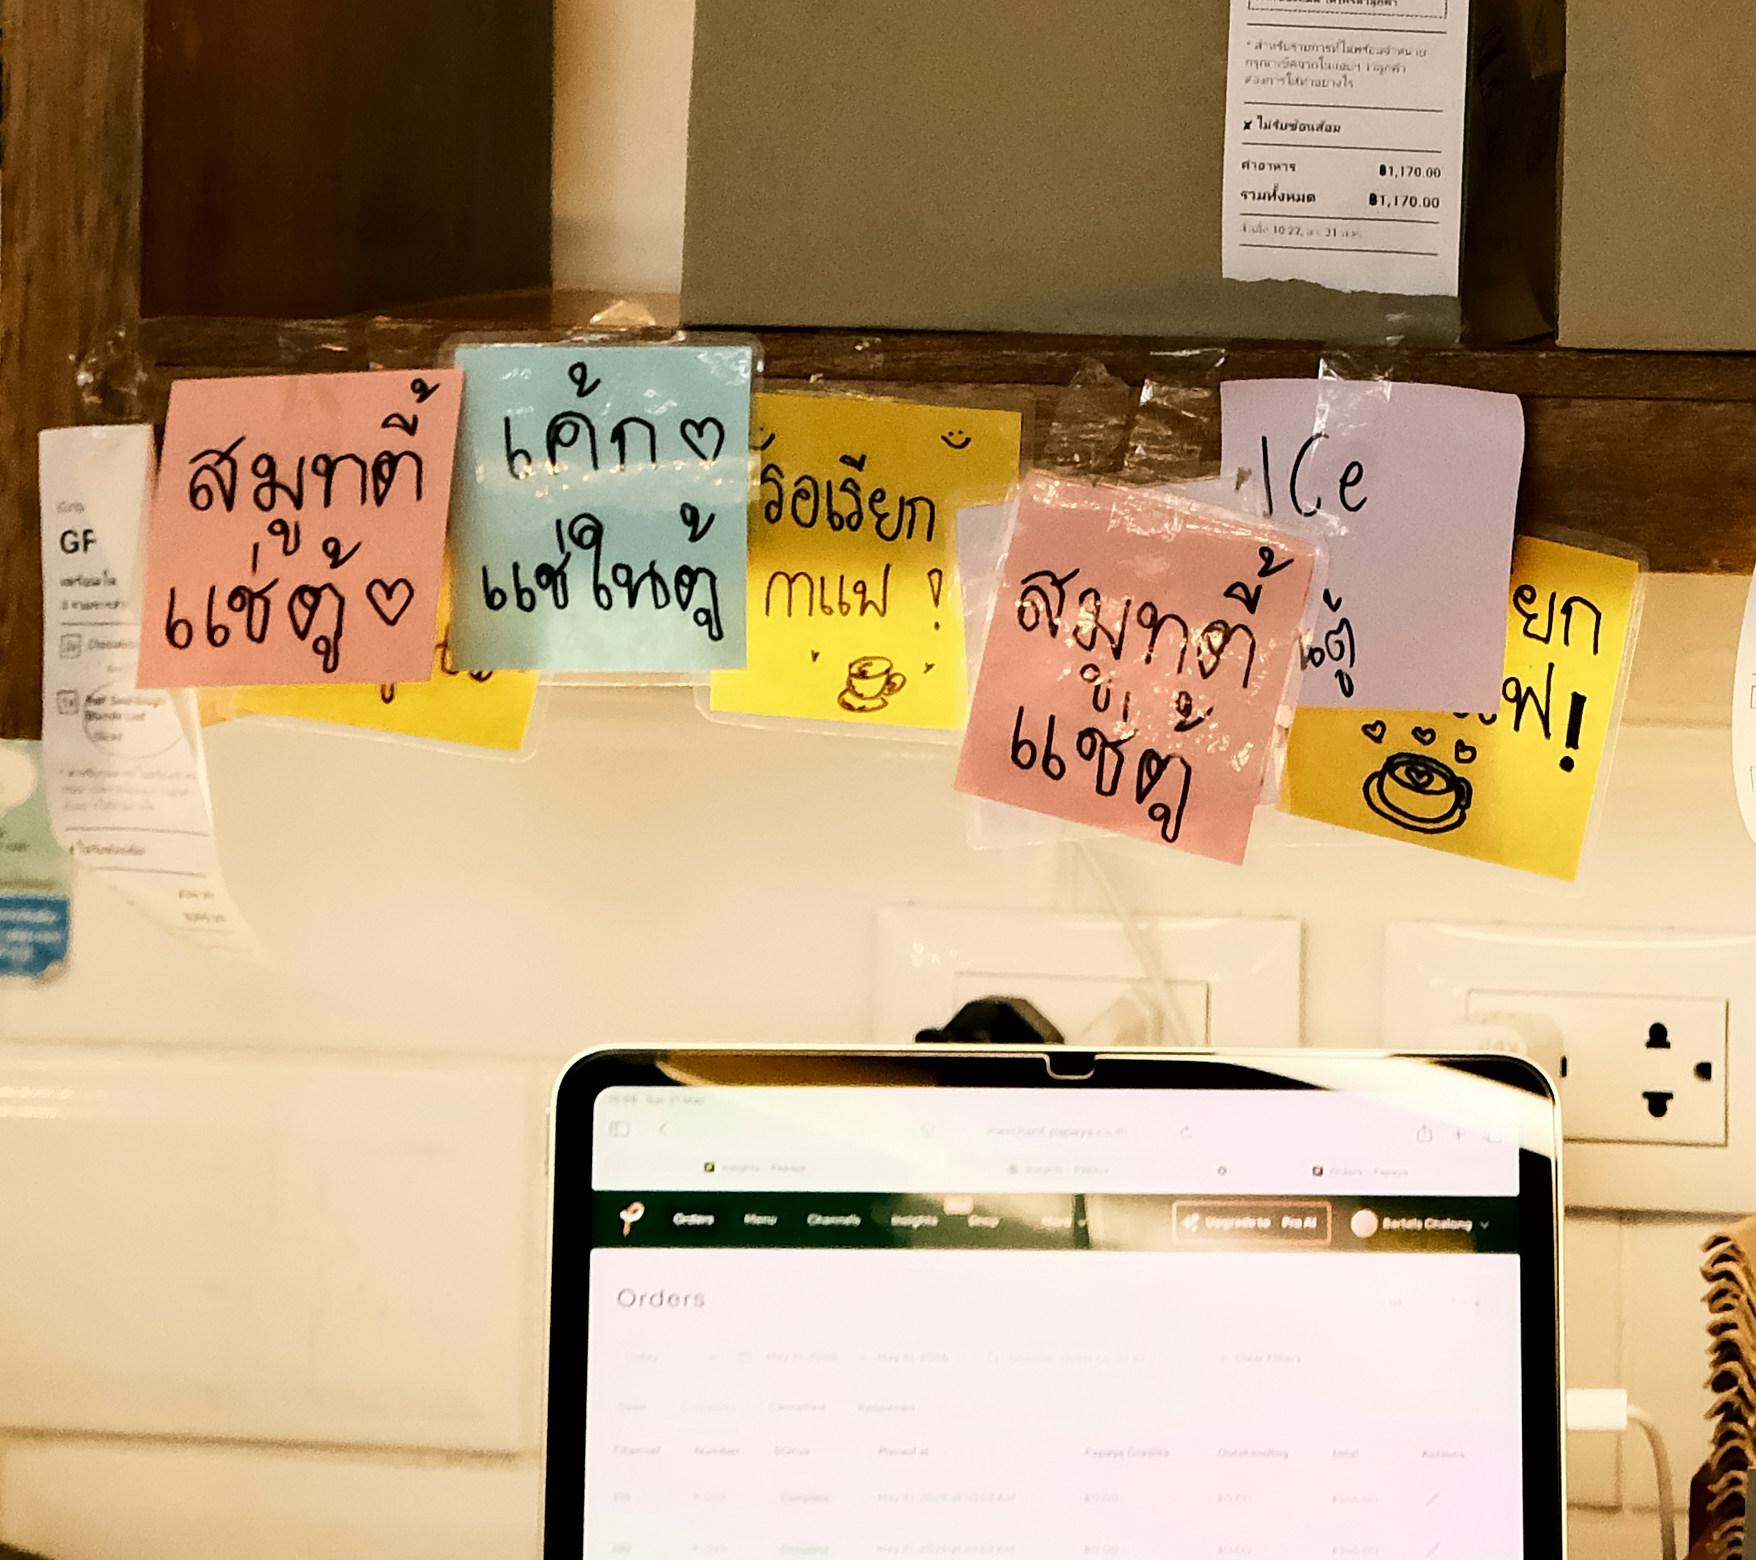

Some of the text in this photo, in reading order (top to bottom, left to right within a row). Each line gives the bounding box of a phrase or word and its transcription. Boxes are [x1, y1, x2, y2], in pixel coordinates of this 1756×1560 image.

[1240, 183, 1316, 203] รวมทั้งหมด
[1241, 160, 1297, 172] ค่าอาหาร
[187, 376, 442, 558] สมูทตี้
[502, 360, 659, 481] เค้ก
[58, 529, 99, 555] GF
[760, 452, 938, 544] รอเรียก
[164, 534, 365, 676] แช่ตู้
[480, 501, 726, 643] แช่ในตู้
[1014, 544, 1297, 717] สมูทตี้
[1007, 687, 1216, 846] แช่ตู้
[615, 1286, 707, 1311] Orders
